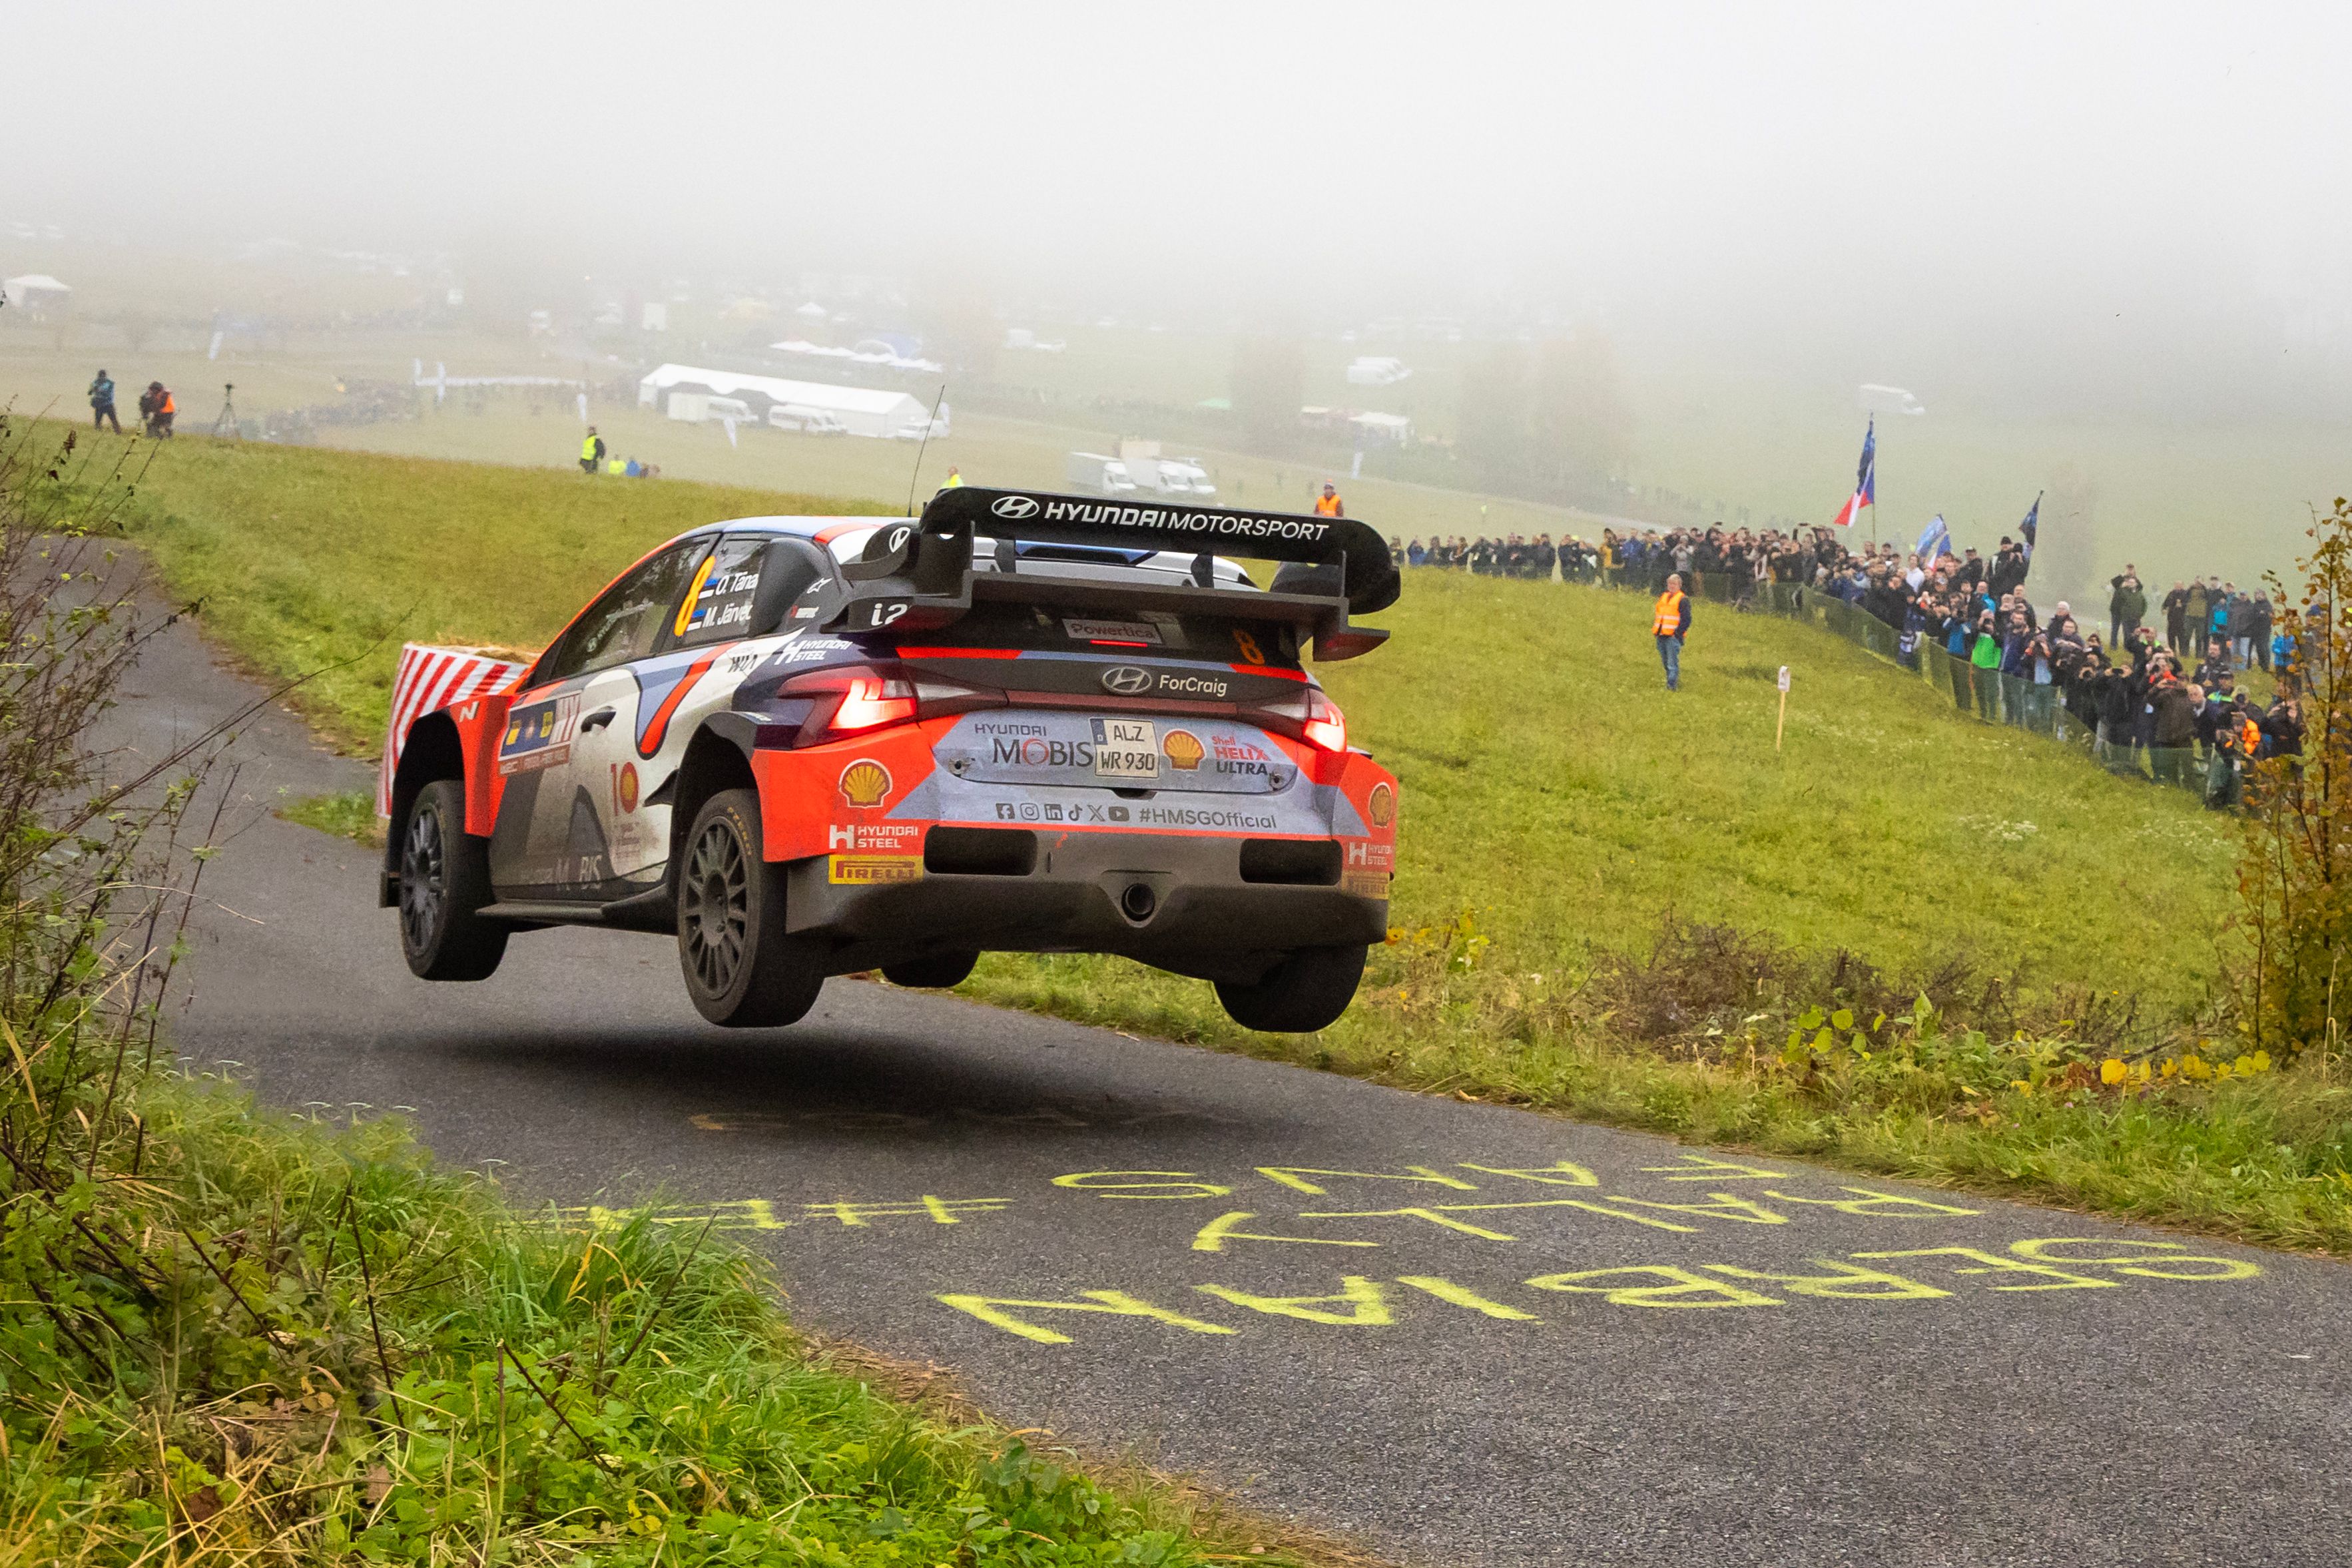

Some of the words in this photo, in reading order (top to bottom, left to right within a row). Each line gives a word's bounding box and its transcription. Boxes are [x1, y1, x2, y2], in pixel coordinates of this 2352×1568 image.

[1044, 501, 1167, 528] HYUNDAI
[1168, 512, 1329, 541] MOTORSPORT
[715, 575, 730, 595] O.
[730, 571, 759, 593] Täna
[673, 555, 717, 637] 8
[702, 606, 718, 628] M.
[870, 602, 910, 627] i2
[1070, 623, 1155, 639] Powertica
[802, 639, 853, 650] HYUNDAI
[1233, 629, 1265, 665] 8
[792, 650, 827, 662] STEEL
[1159, 674, 1227, 697] ForCraig
[974, 723, 1047, 736] HYUNDAI
[1113, 724, 1145, 742] ALZ
[1211, 734, 1236, 746] Shell
[992, 737, 1094, 767] MOBIS
[1101, 751, 1121, 770] WR
[1125, 752, 1155, 771] 930
[1214, 745, 1271, 761] HELIX
[1216, 761, 1268, 776] ULTRA
[1139, 807, 1277, 829] #HMSGOfficial
[858, 826, 918, 836] HYUNDAI
[858, 838, 902, 848] STEEL
[836, 860, 916, 879] PIRELLI
[1051, 1155, 1789, 1199] FANS
[1193, 1186, 1984, 1252] RALLY
[935, 1238, 2263, 1344] SERBIAN
